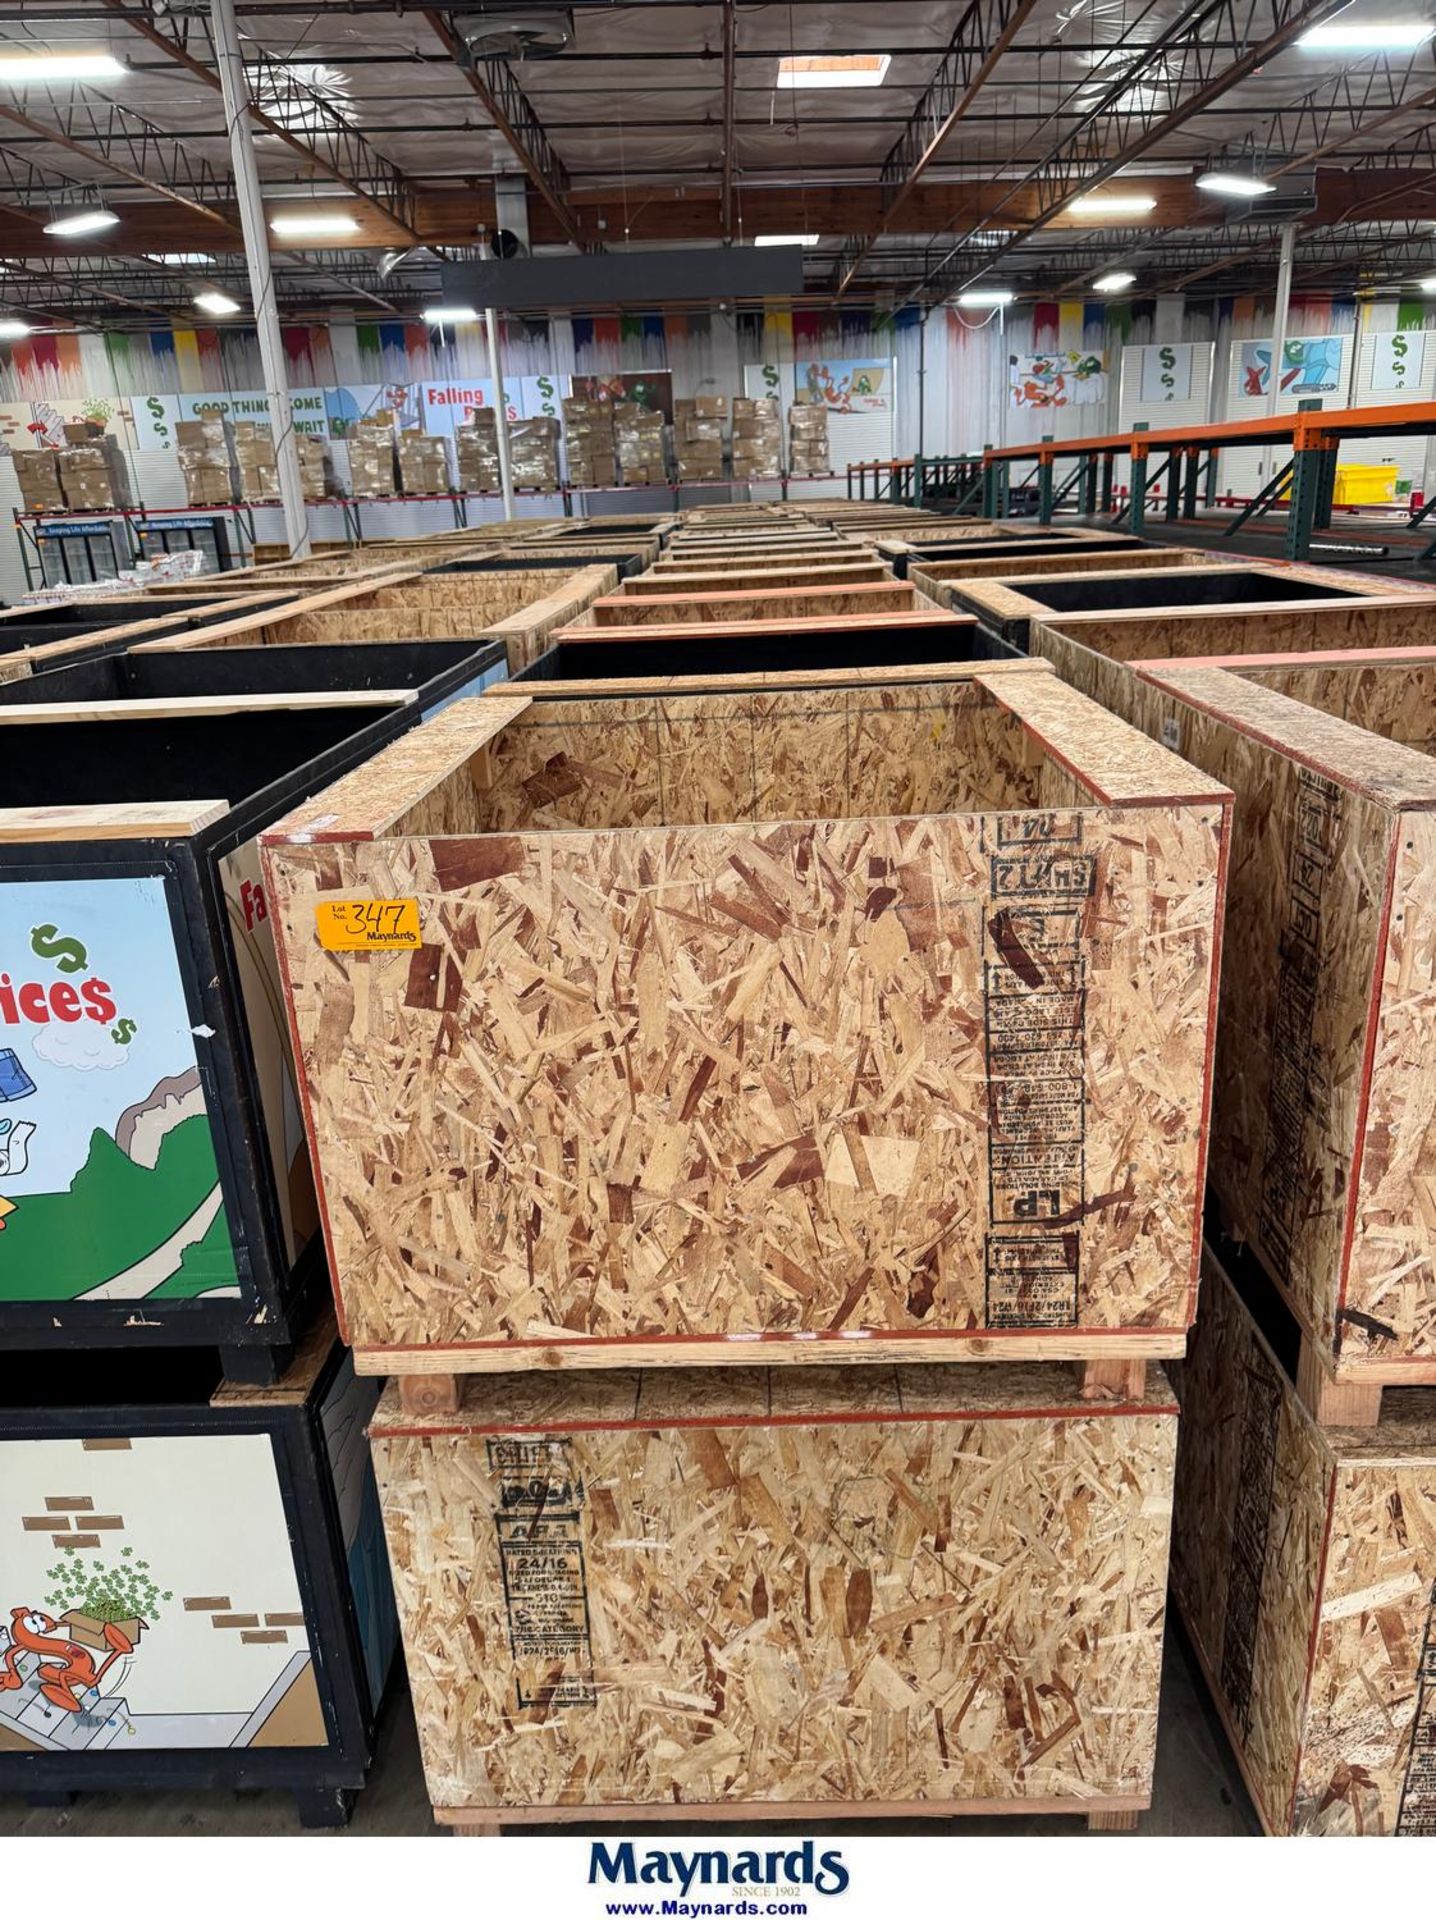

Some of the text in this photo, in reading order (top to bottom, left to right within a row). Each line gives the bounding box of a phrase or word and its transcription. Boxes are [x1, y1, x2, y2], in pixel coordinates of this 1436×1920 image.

[428, 389, 483, 406] Falling
[192, 402, 229, 415] GOOD
[290, 396, 323, 410] OME
[332, 905, 346, 913] Lot
[333, 913, 348, 921] No.
[345, 902, 406, 935] 347
[366, 930, 417, 942] Maynards
[1013, 1190, 1060, 1216] LP
[518, 1557, 568, 1569] 24/16
